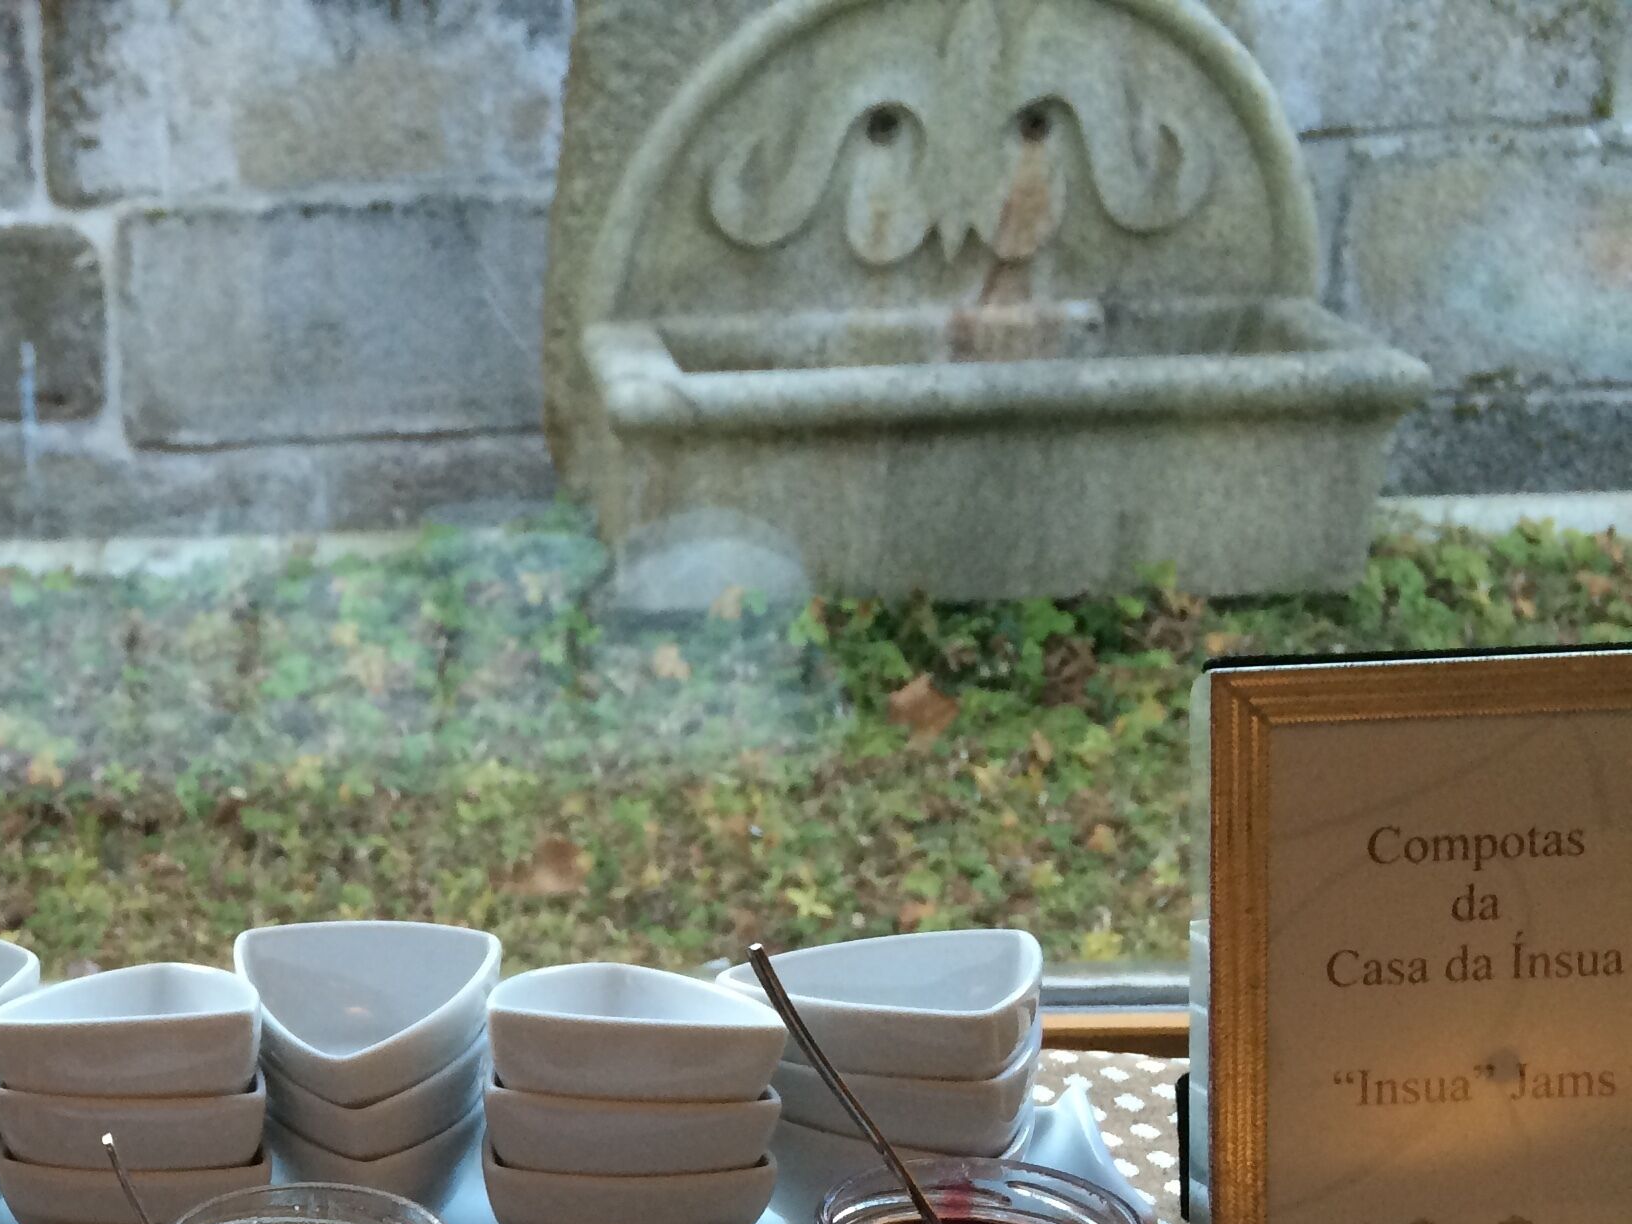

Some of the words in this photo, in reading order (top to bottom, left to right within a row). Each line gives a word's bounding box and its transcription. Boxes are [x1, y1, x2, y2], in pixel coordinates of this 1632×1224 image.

[1367, 825, 1586, 872] Compotas
[1451, 883, 1500, 922] da
[1326, 949, 1429, 988] Casa
[1444, 944, 1494, 982] da
[1512, 931, 1624, 980] Ínsua
[1509, 1062, 1617, 1101] Jams
